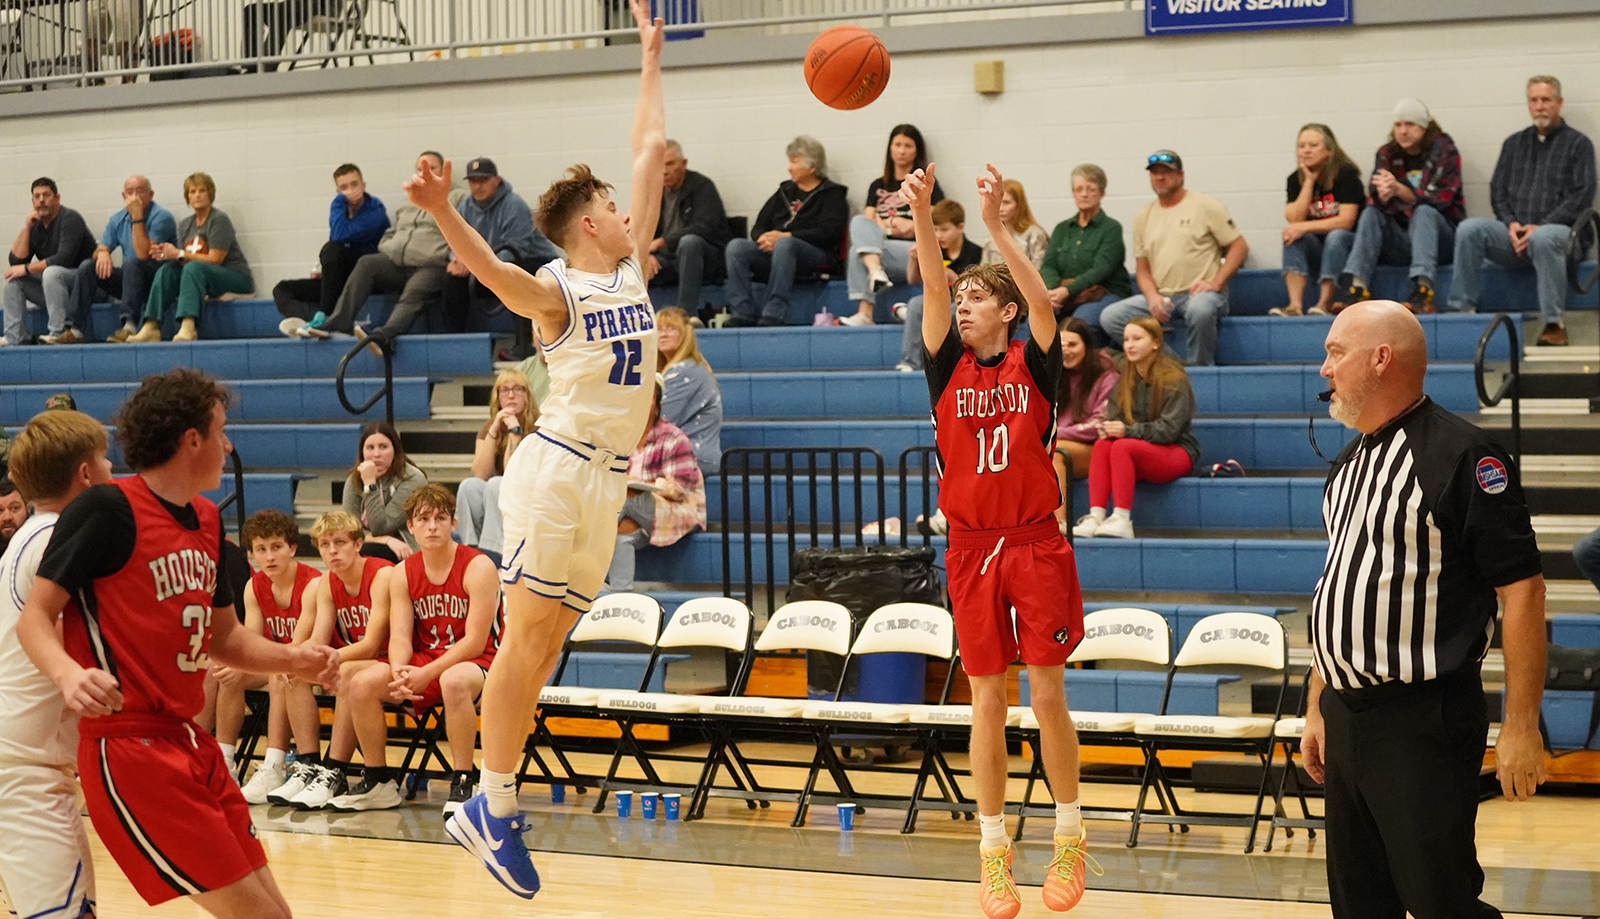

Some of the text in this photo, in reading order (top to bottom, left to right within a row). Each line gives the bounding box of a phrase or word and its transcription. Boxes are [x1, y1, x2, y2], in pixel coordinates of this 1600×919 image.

[1167, 0, 1241, 14] VISITOR
[582, 303, 654, 342] PIRATES
[608, 339, 642, 386] 12
[956, 383, 1029, 418] HOUSTON
[976, 422, 1009, 474] 10
[590, 607, 646, 624] CABOOL
[679, 611, 736, 629] CABOOL
[776, 615, 838, 632] CABOOL
[873, 618, 939, 636] CABOOL
[1085, 623, 1155, 641] CABOOL
[429, 624, 455, 650] 11
[1200, 628, 1270, 646] CABOOL
[609, 699, 657, 710] BULLDOGS
[714, 703, 765, 714] BULLDOGS
[817, 709, 872, 720] BULLDOGS
[1154, 723, 1215, 734] BULLDOGS
